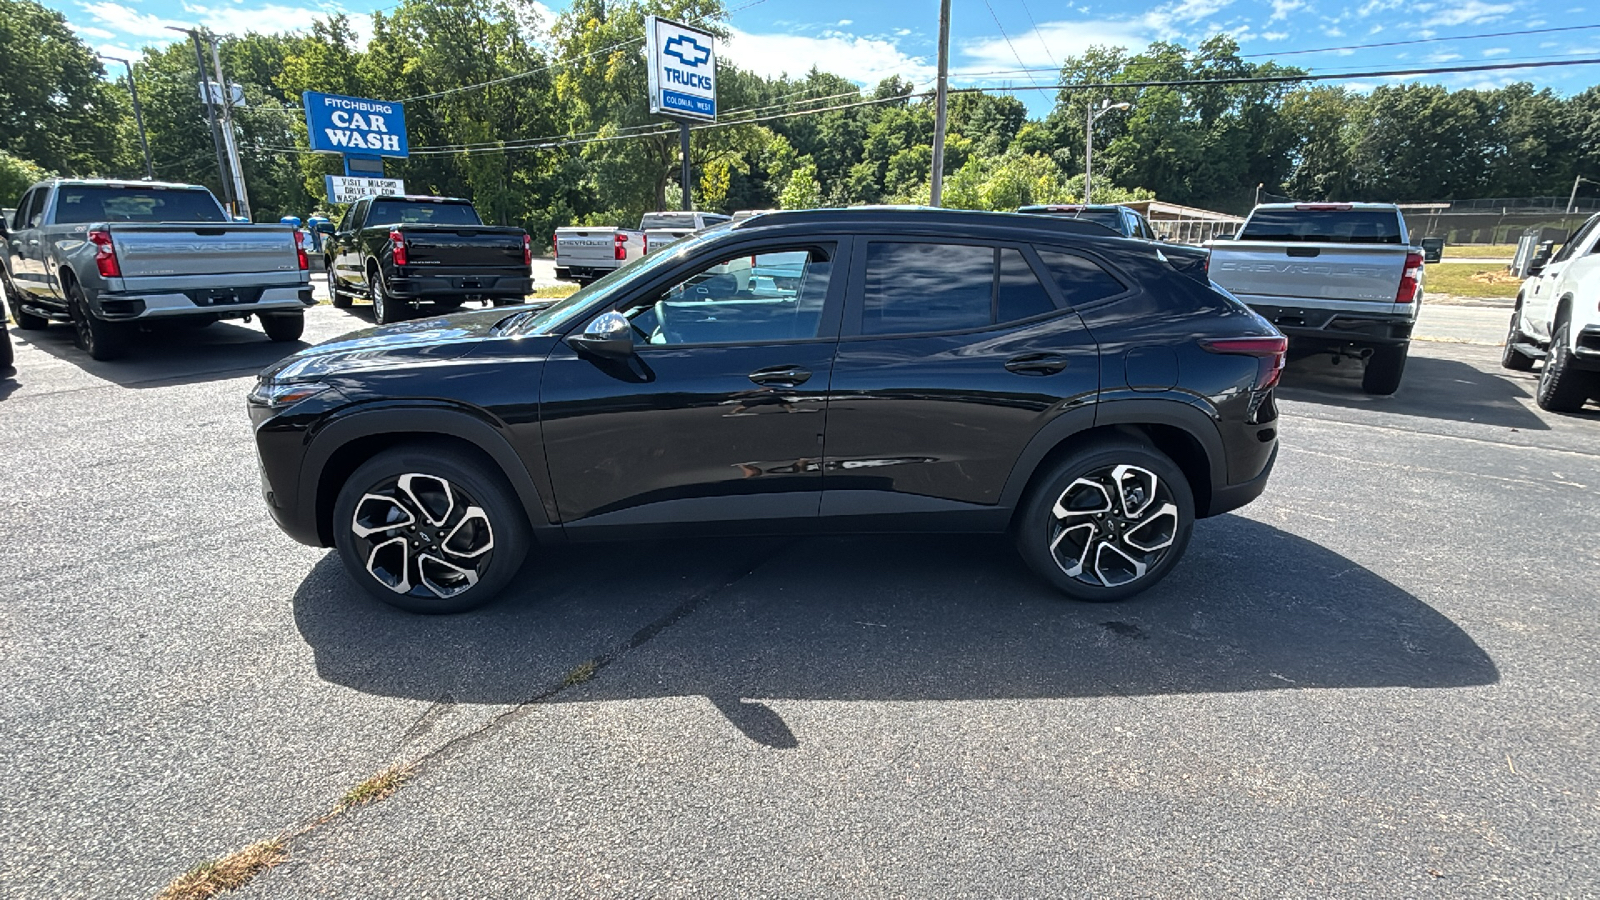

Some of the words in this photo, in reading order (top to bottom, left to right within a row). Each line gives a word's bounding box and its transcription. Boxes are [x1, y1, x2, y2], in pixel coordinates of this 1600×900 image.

[663, 66, 712, 90] TRUCKS
[324, 97, 392, 114] FITCHBURG
[666, 95, 694, 108] COLONIAL
[696, 101, 711, 111] WEST
[331, 110, 388, 132] CAR
[325, 128, 401, 151] WASH
[341, 178, 361, 187] VISIT
[367, 179, 397, 188] MILFORD
[344, 187, 366, 195] DRIVE
[1220, 262, 1389, 277] CHEVROLET
